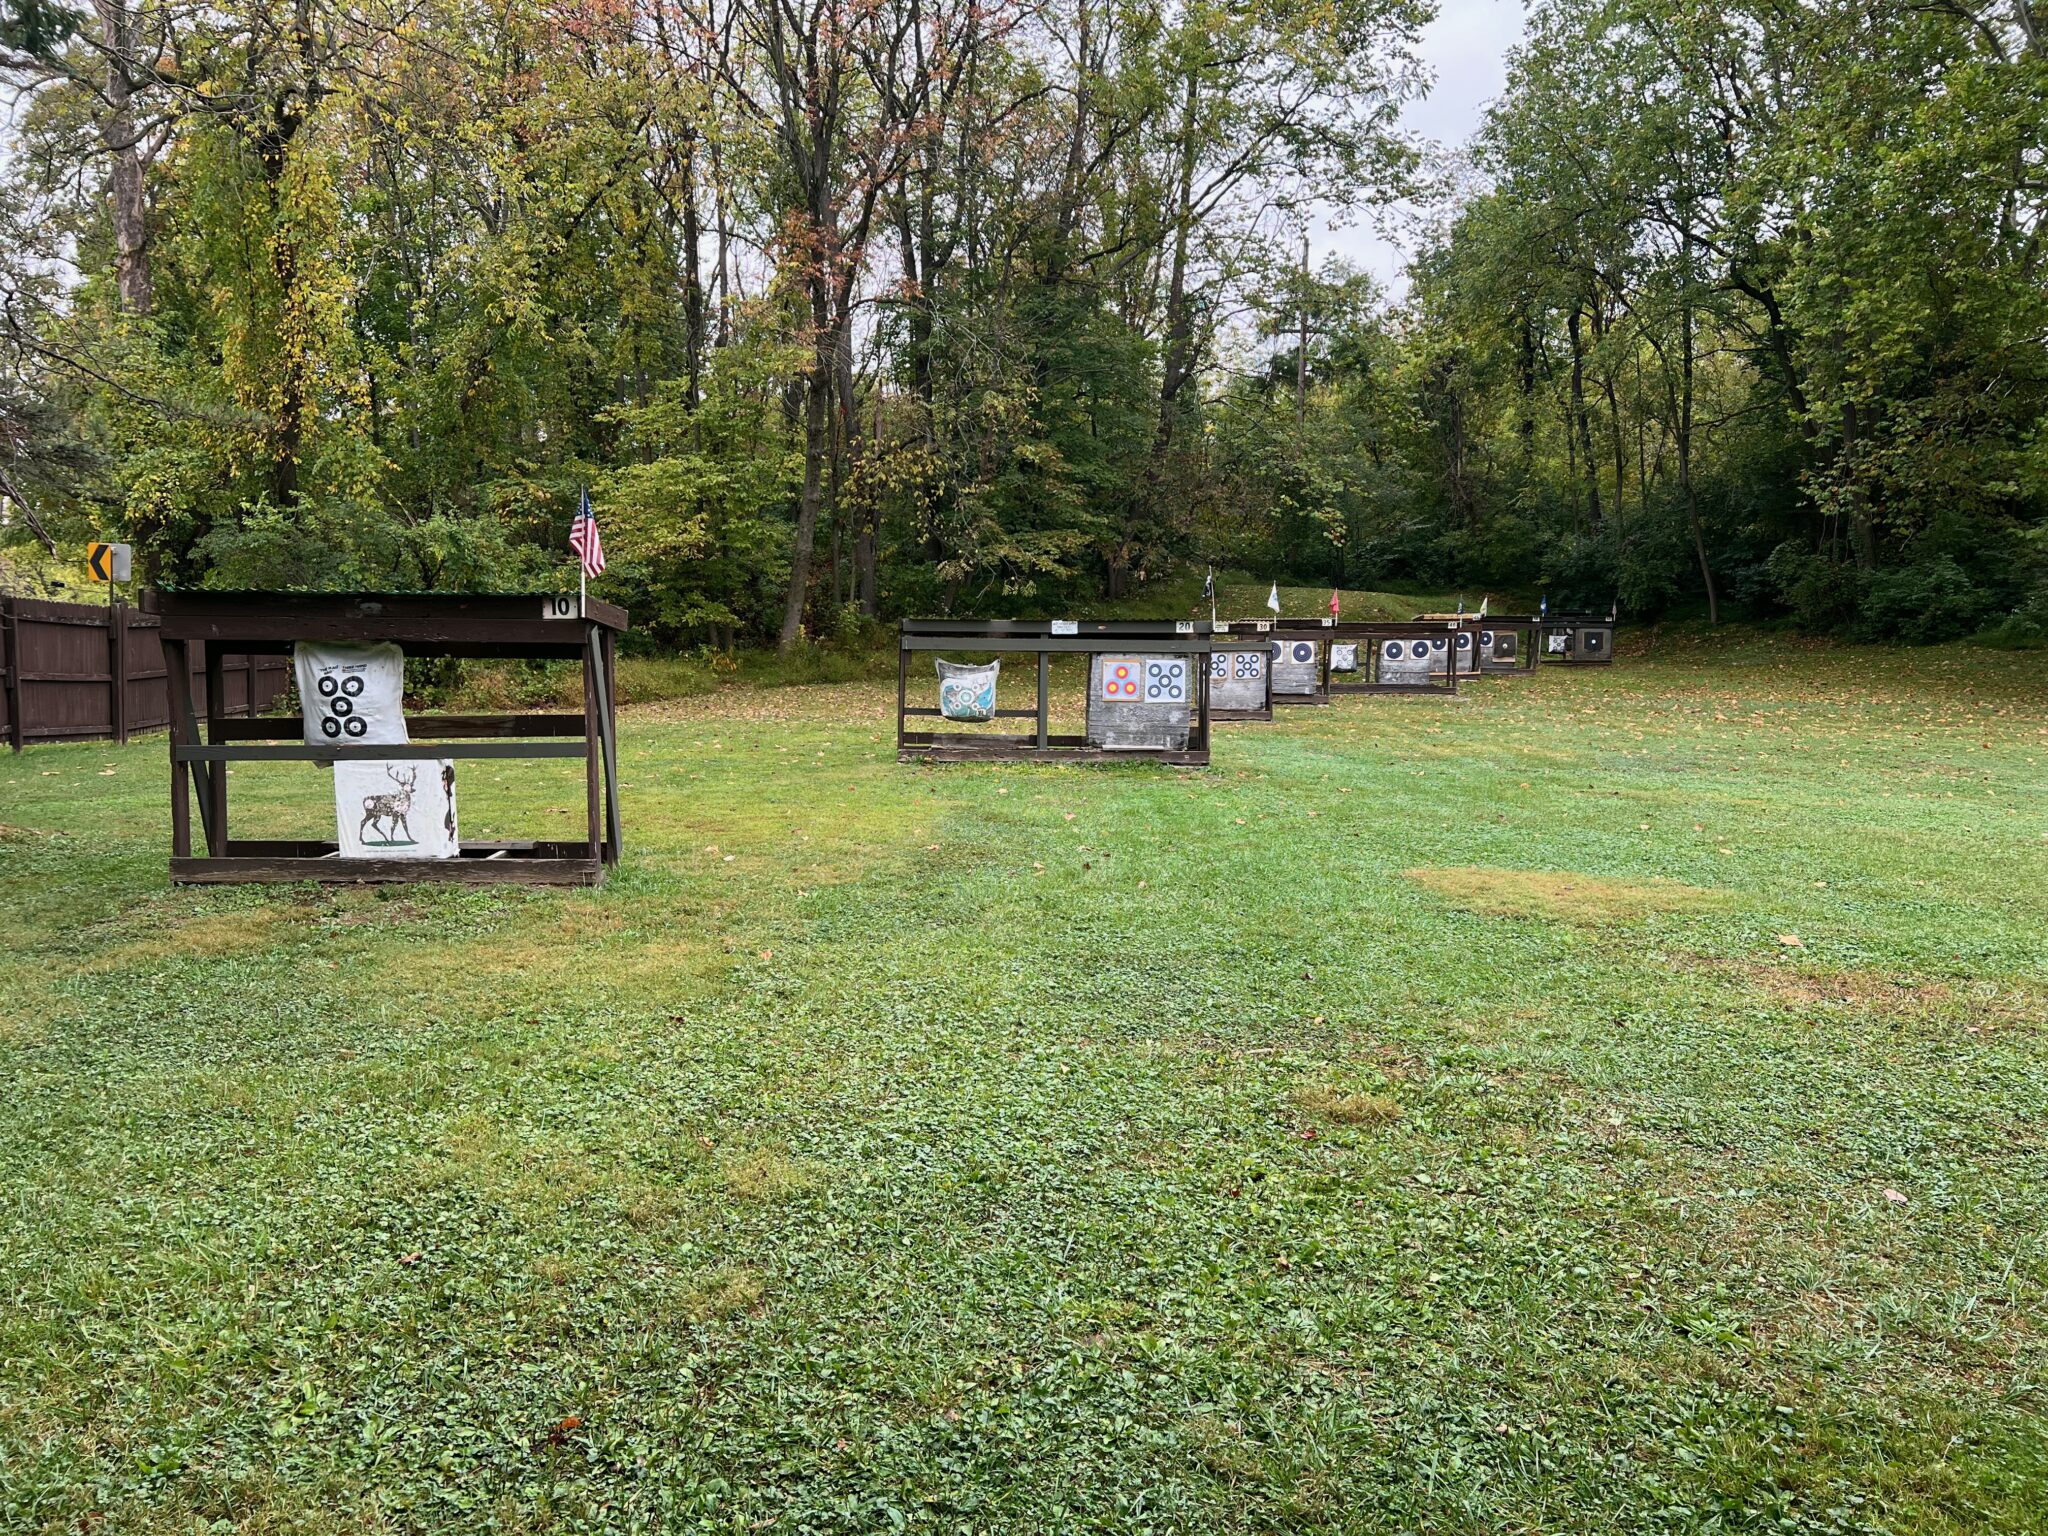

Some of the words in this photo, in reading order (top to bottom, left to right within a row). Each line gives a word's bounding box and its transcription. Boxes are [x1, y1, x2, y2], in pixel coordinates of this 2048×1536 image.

[550, 597, 570, 616] 10
[1178, 622, 1191, 631] 20
[1258, 623, 1268, 631] 30
